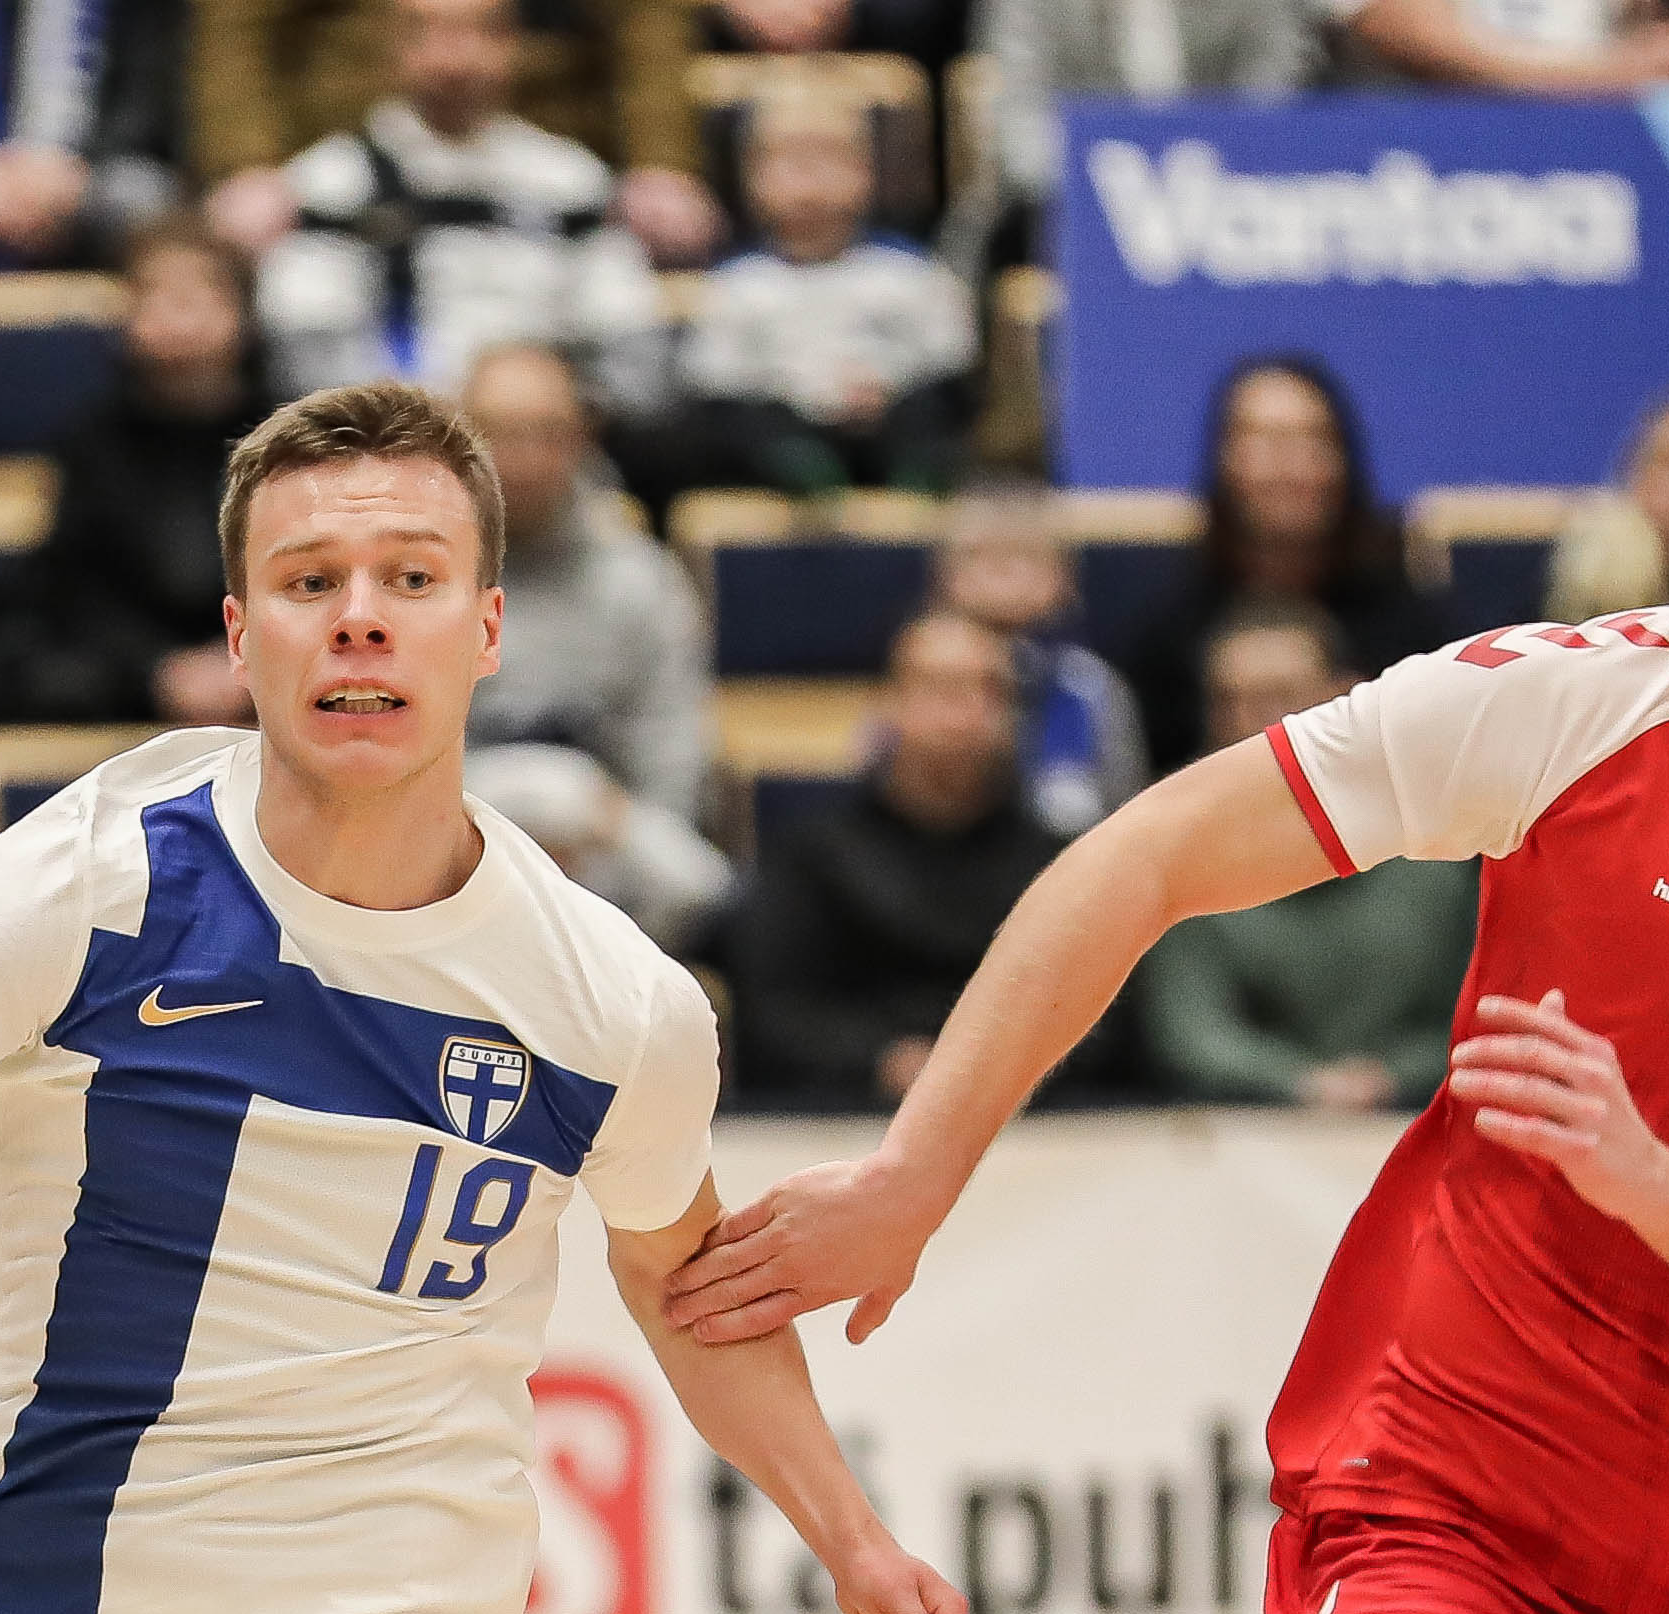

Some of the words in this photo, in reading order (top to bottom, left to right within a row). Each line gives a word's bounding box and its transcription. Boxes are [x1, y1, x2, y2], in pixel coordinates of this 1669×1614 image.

[1091, 140, 1639, 285] Vantaa
[458, 1047, 518, 1066] SUOMI
[377, 1143, 537, 1300] 19
